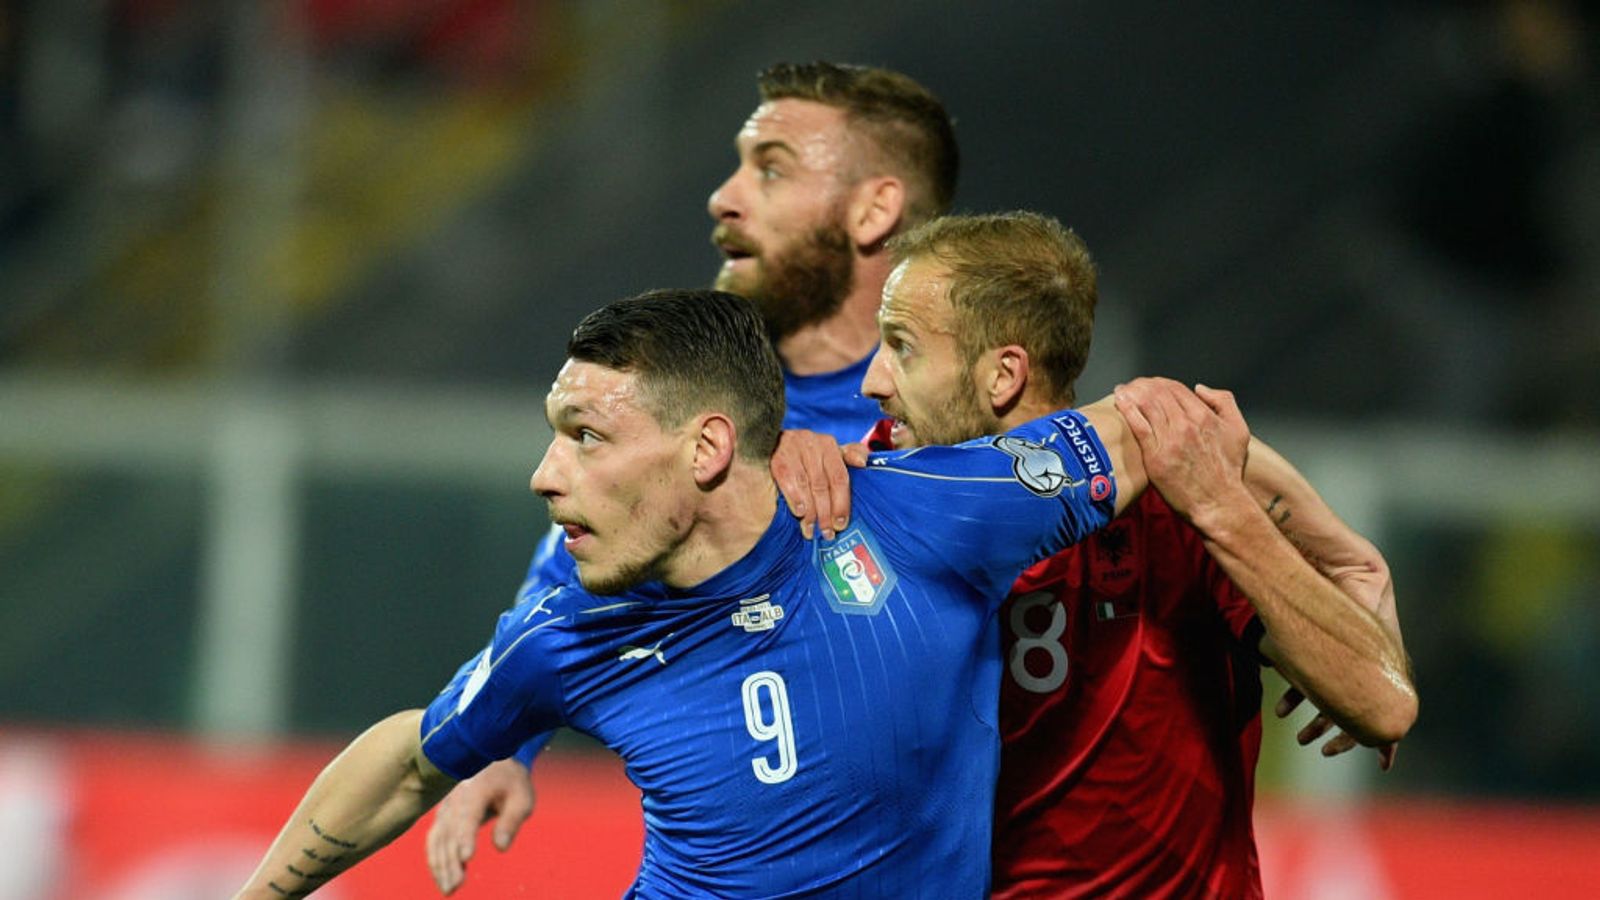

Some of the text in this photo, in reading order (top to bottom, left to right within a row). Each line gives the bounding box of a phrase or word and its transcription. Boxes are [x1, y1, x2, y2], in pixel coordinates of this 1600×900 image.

[1053, 415, 1101, 474] RESPECT
[823, 538, 858, 562] ITALIA
[732, 612, 750, 626] ITA
[762, 606, 783, 621] ALB
[1010, 592, 1068, 693] 8
[742, 671, 796, 784] 9
